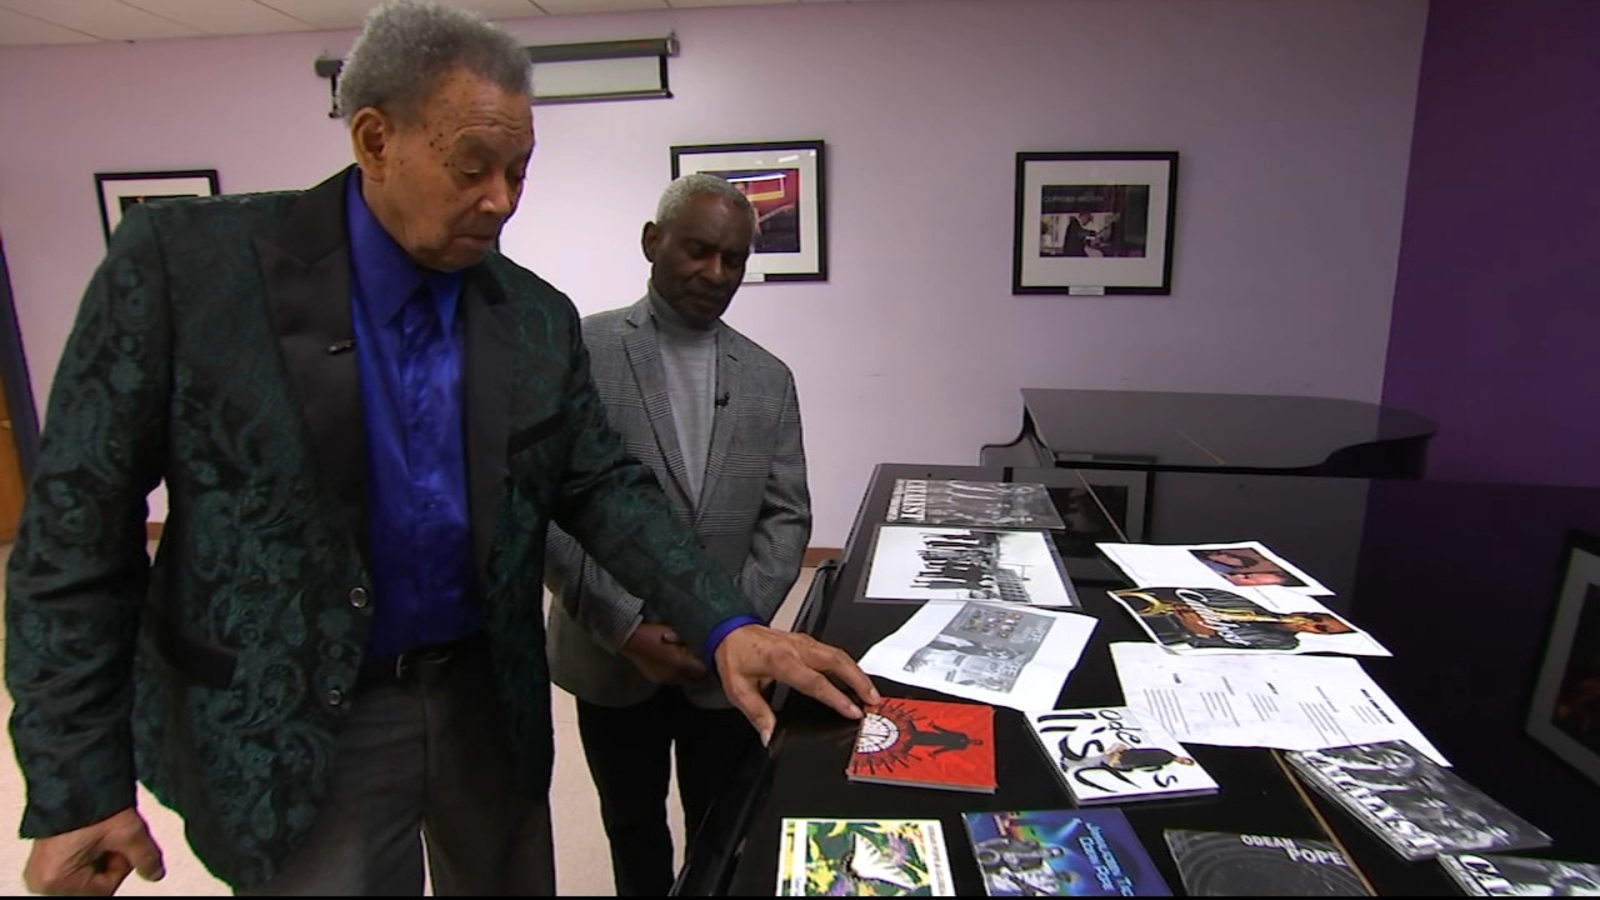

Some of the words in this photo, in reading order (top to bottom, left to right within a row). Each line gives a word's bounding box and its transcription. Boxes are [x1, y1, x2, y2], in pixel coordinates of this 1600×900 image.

[1303, 751, 1443, 850] CATALYST
[1240, 834, 1297, 848] ODEAN
[1287, 847, 1348, 867] POPE
